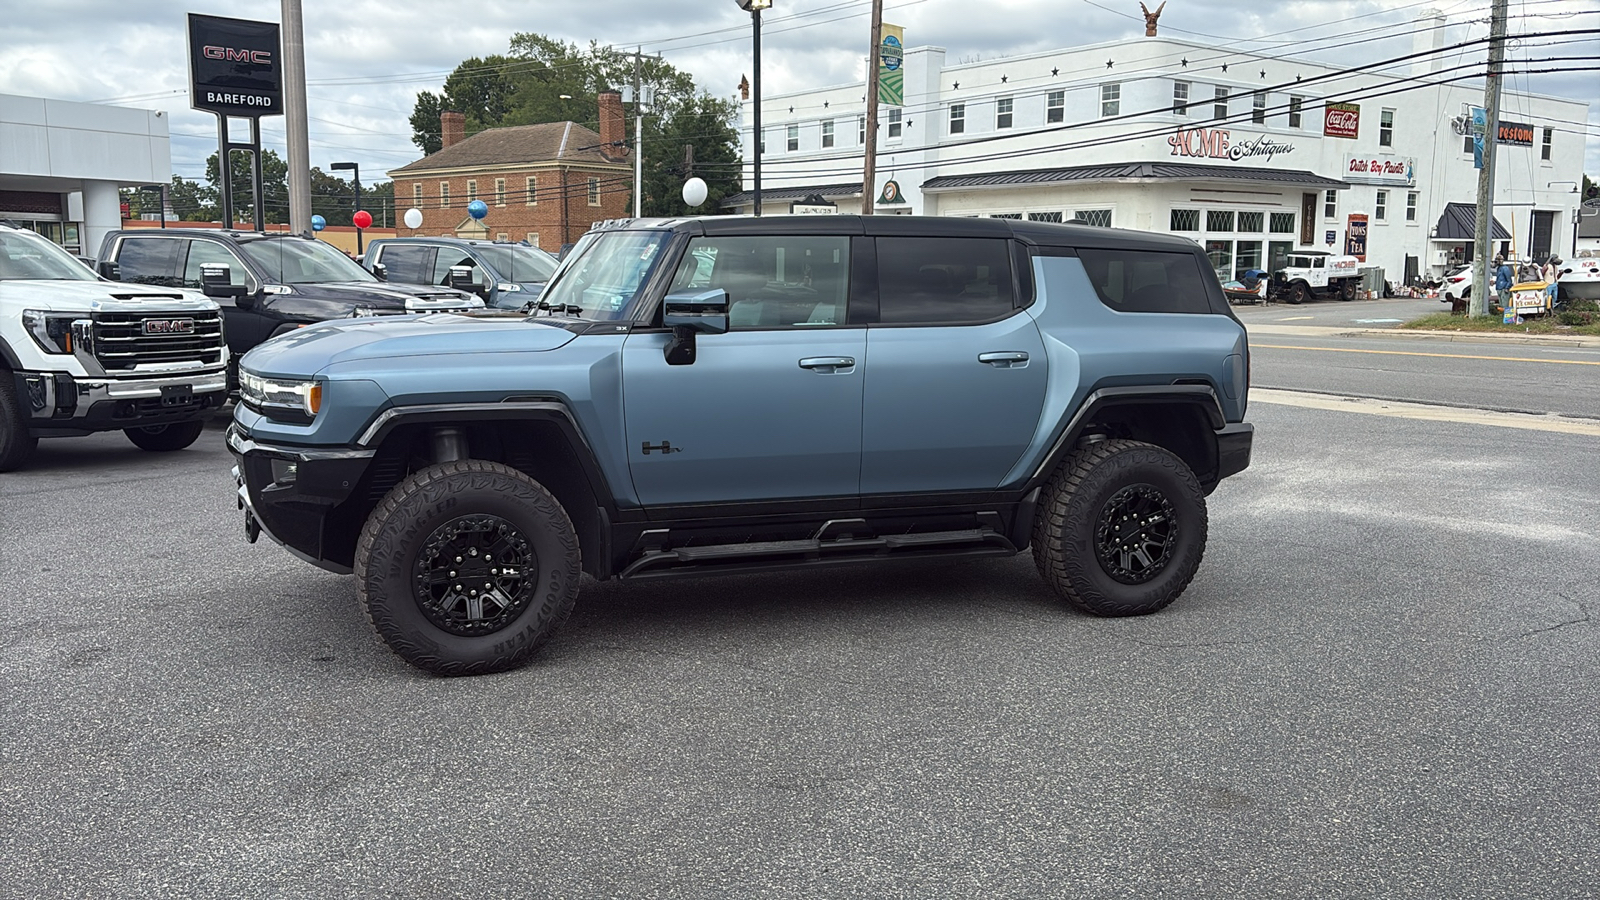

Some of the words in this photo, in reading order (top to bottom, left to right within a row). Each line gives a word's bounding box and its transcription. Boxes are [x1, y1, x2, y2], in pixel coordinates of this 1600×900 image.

[203, 45, 272, 64] GMC
[207, 92, 272, 106] BAREFORD
[1499, 126, 1533, 141] restone
[1168, 127, 1230, 159] ACME
[1230, 134, 1295, 162] Antiques
[1349, 158, 1369, 173] Dutch
[1370, 159, 1383, 176] Boy
[1383, 160, 1404, 174] Paints
[1350, 241, 1364, 253] TEA
[147, 320, 194, 333] GMC
[389, 497, 458, 579] WRANGLER
[493, 568, 563, 656] GOODYEAR
